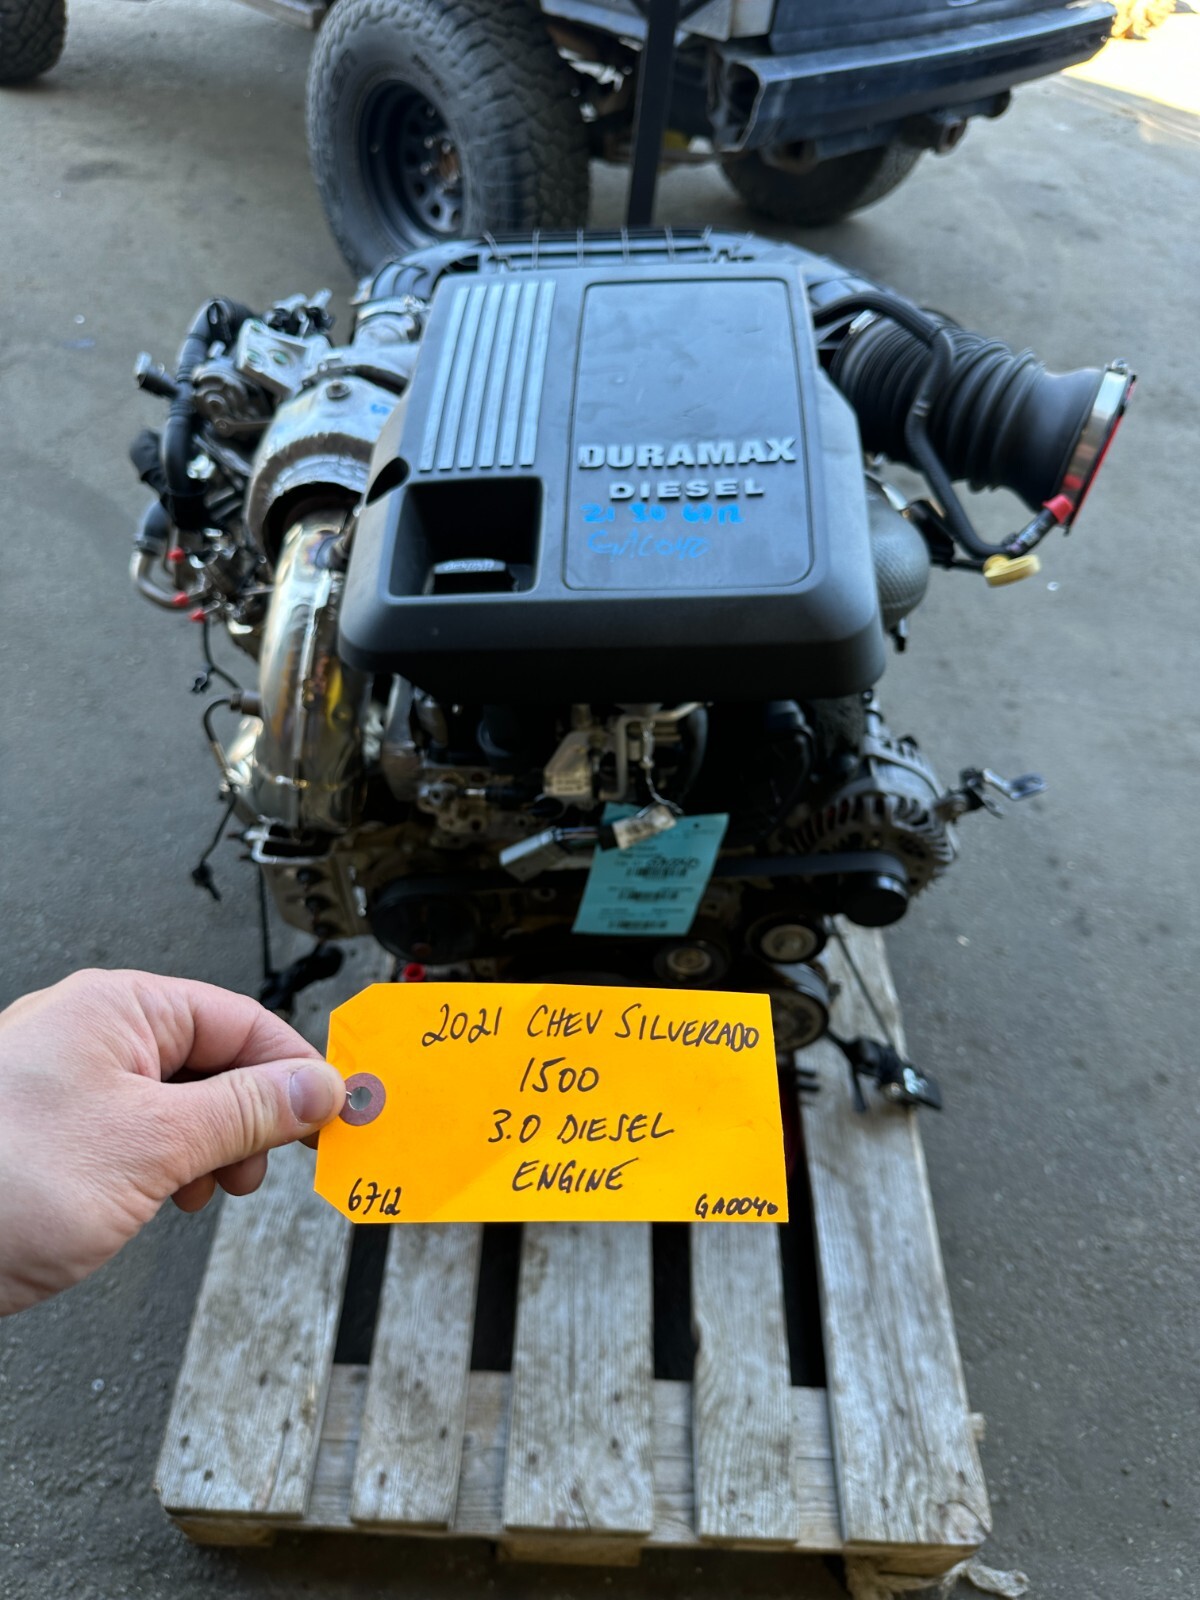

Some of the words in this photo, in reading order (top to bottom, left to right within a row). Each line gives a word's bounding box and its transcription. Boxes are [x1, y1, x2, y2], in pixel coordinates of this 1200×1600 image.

[578, 438, 796, 470] DURAMAX
[609, 479, 765, 502] DIESEL
[422, 1004, 502, 1047] 2021
[527, 1005, 602, 1038] CHEV
[615, 1003, 759, 1052] SILVERADO
[519, 1057, 599, 1093] 1500
[488, 1109, 541, 1144] 3.0
[556, 1112, 675, 1144] DIESEL
[511, 1158, 639, 1193] ENGINE
[348, 1178, 403, 1216] 6712
